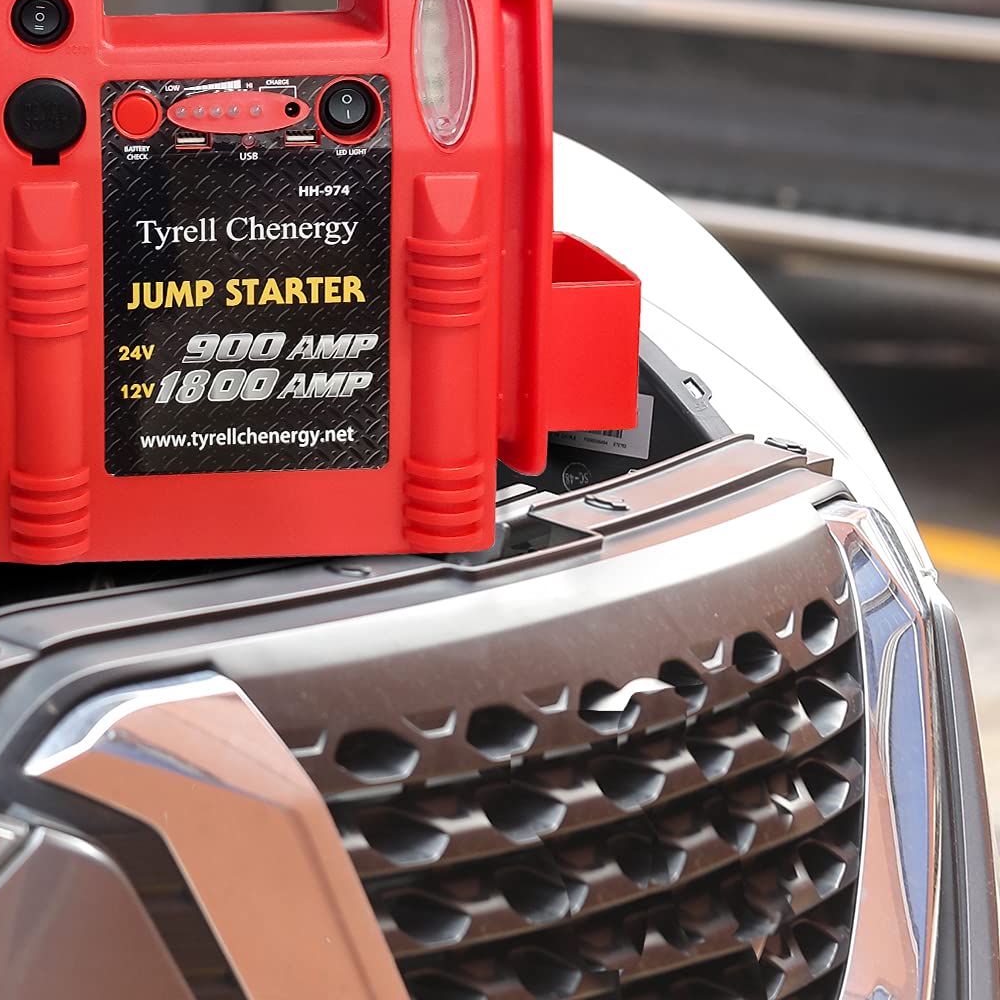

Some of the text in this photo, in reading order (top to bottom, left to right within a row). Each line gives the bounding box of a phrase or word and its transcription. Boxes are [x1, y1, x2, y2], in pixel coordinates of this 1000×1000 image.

[123, 145, 151, 153] BATTERY
[126, 153, 149, 161] CHECK
[239, 152, 259, 161] USB
[348, 148, 367, 156] LIGHT
[298, 184, 350, 197] HH-974
[136, 215, 359, 250] Tyrell Chenergy
[127, 275, 366, 310] JUMP STARTER
[118, 331, 379, 364] 24V 900 AMP
[120, 367, 374, 404] 12V 1800 AMP
[140, 427, 355, 451] www.tyrellchenergy.net
